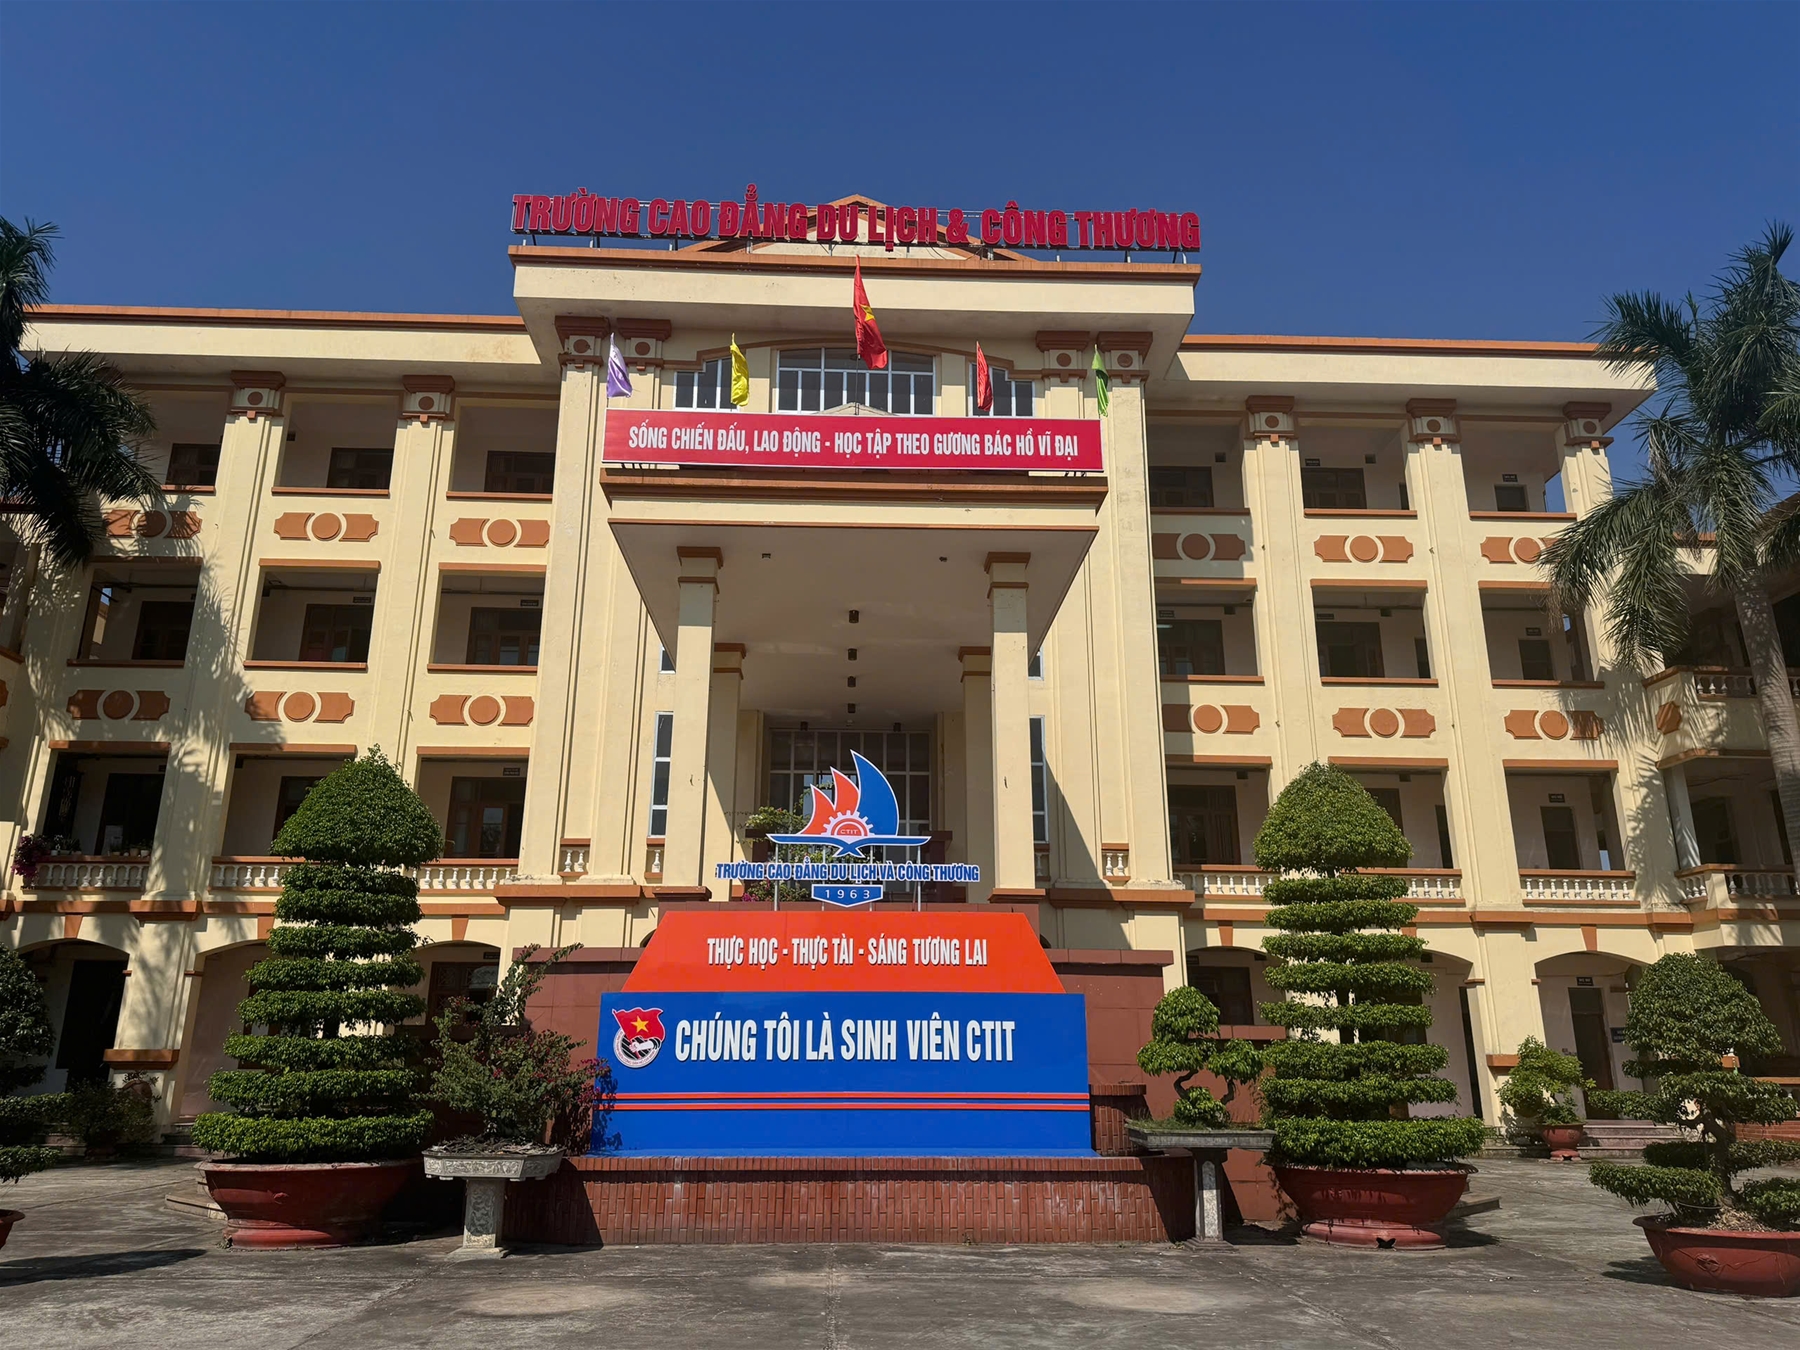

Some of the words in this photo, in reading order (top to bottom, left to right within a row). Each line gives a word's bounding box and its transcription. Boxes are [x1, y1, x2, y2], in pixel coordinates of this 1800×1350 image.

[513, 187, 640, 234] TRƯỜNG
[647, 199, 711, 237] CAO
[718, 183, 808, 239] ĐẲNG
[817, 203, 858, 241] DU
[868, 206, 938, 252] LỊCH
[946, 208, 969, 244] &
[981, 200, 1068, 247] CÔNG
[1074, 208, 1200, 249] THƯƠNG
[628, 419, 667, 449] SỐNG
[671, 422, 713, 450] CHIẾN
[717, 422, 749, 454] ĐẤU,
[753, 430, 779, 452] LAO
[783, 427, 820, 457] ĐỘNG
[834, 432, 862, 458] HỌC
[866, 428, 892, 459] TẬP
[896, 433, 929, 455] THEO
[934, 432, 980, 455] GƯƠNG
[984, 430, 1012, 456] BÁC
[1016, 428, 1034, 456] HỒ
[1038, 431, 1051, 456] VĨ
[1055, 435, 1079, 460] ĐẠI
[716, 861, 763, 879] TRƯỜNG
[767, 863, 791, 880] CAO
[794, 857, 828, 880] ĐẲNG
[830, 863, 848, 880] DU
[850, 863, 877, 884] LỊCH
[878, 861, 896, 880] VÀ
[897, 862, 930, 881] CÔNG
[933, 863, 980, 882] THƯƠNG
[825, 890, 870, 898] 1963
[707, 935, 744, 969] THỰC
[749, 937, 778, 969] HỌC
[792, 935, 828, 969] THỰC
[832, 934, 854, 965] TÀI
[868, 933, 907, 965] SÁNG
[913, 935, 960, 966] TƯƠNG
[965, 938, 988, 966] LAI
[675, 1012, 757, 1061] CHÚNG
[764, 1012, 800, 1061] TÔI
[806, 1012, 835, 1061] LÀ
[841, 1019, 897, 1061] SINH
[906, 1012, 960, 1061] VIÊN
[966, 1020, 1016, 1061] CTIT
